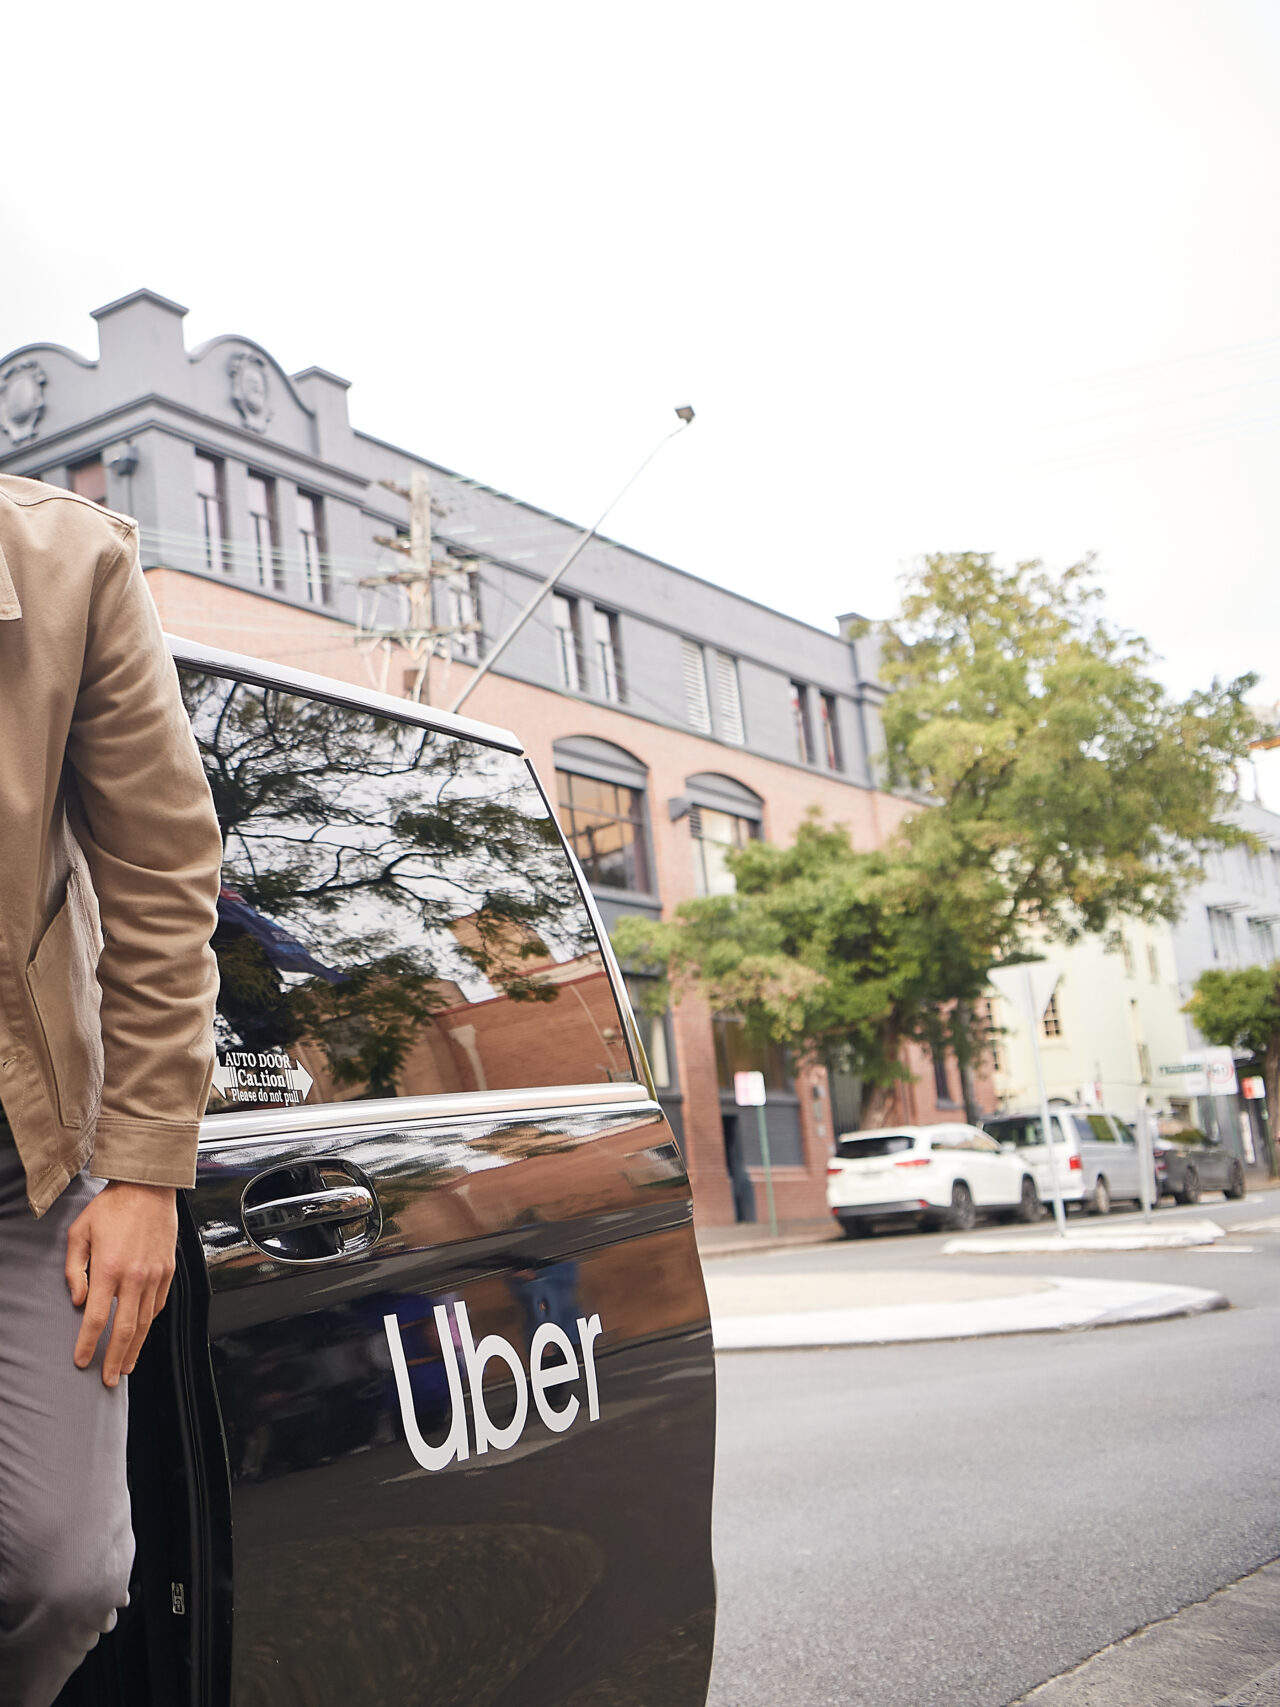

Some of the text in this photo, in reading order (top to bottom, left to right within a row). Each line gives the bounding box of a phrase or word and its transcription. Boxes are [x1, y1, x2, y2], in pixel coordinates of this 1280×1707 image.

[225, 1052, 291, 1068] AUTO DOOR
[231, 1088, 300, 1106] Please do not pull
[384, 1301, 602, 1471] Uber
